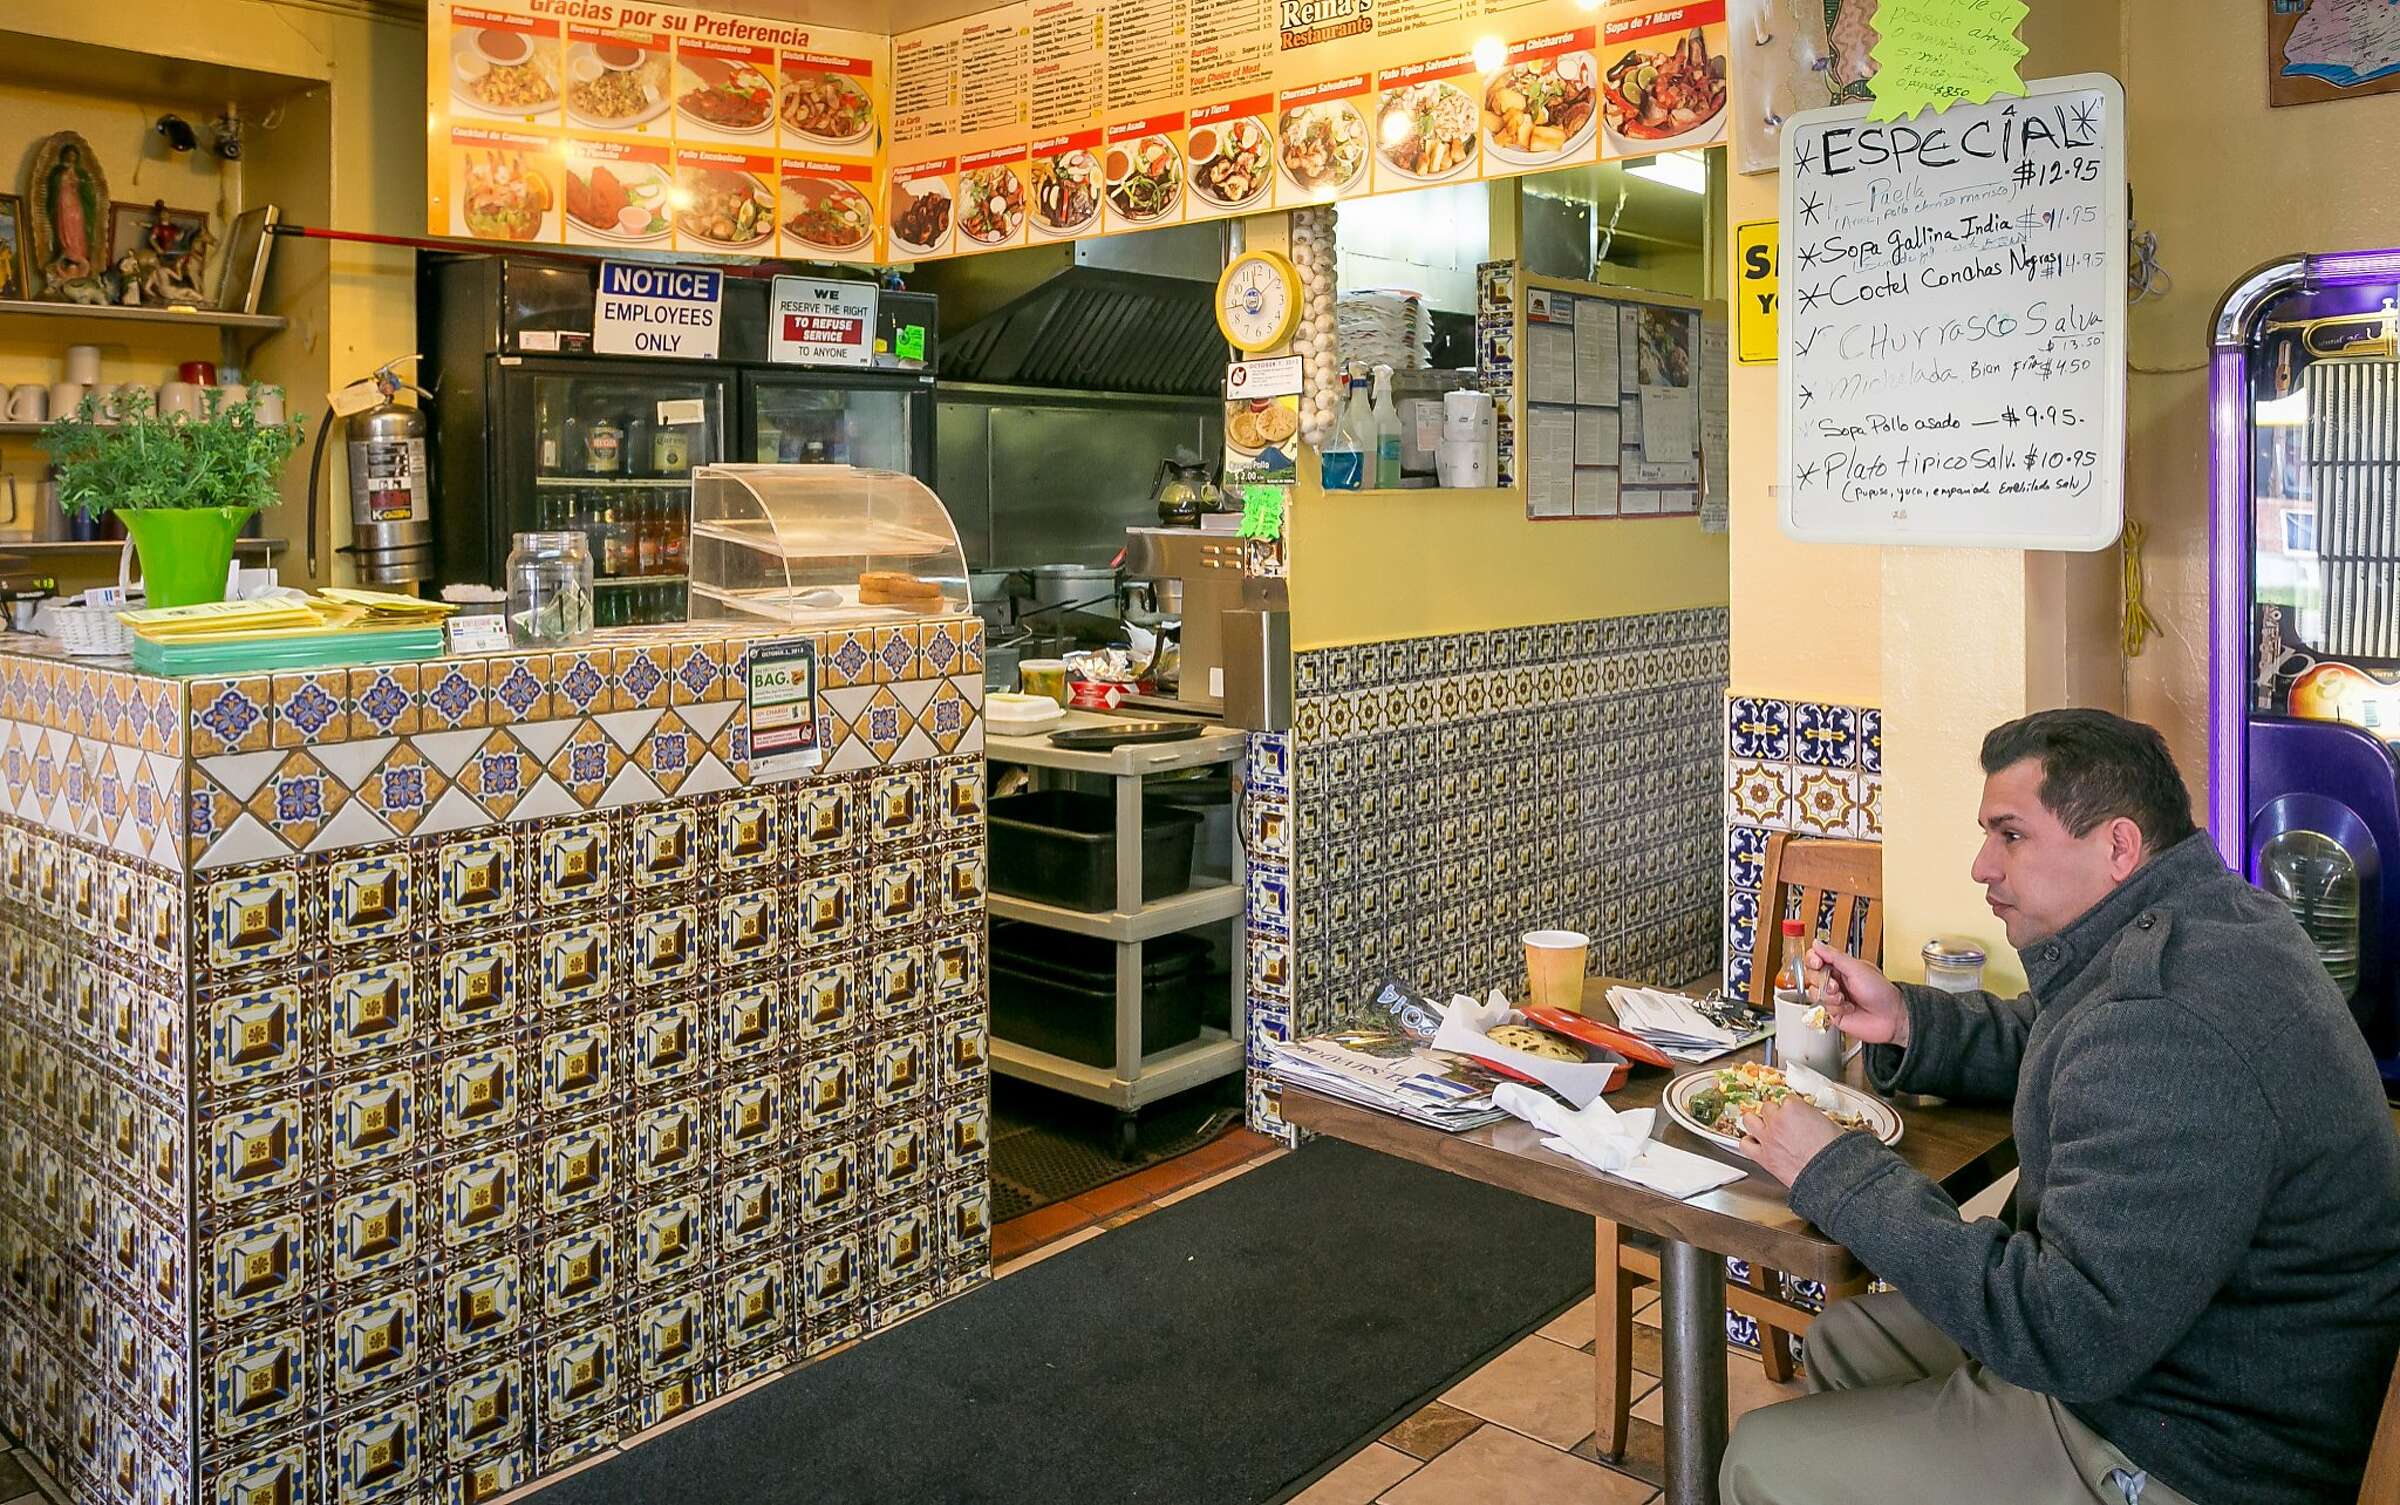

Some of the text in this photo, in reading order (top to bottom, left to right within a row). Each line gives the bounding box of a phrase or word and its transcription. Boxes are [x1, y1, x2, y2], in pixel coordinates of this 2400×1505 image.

[530, 0, 810, 47] Gracias por su Preferencia
[1281, 15, 1372, 51] Restaurante
[1606, 10, 1683, 34] Sopa de 7 Mares
[1379, 69, 1400, 80] Plato
[2012, 157, 2101, 190] $12.95
[1819, 236, 1882, 268] Sopa
[1959, 213, 2013, 239] India
[1745, 244, 1779, 279] S
[613, 267, 710, 299] NOTICE
[814, 288, 839, 300] WE
[1829, 271, 1910, 306] Coctel
[604, 302, 713, 327] EMPLOYEES
[780, 301, 868, 317] RESERVE THE RIGHT
[795, 317, 853, 330] TO REFUSE
[803, 330, 843, 342] SERVICE
[635, 333, 681, 352] ONLY
[798, 346, 847, 358] TO ANYONE
[1818, 418, 1867, 441] Sopa
[1866, 414, 1909, 434] Pollo
[1824, 445, 1888, 490] Plato
[2024, 443, 2096, 471] $10.95
[755, 671, 790, 688] BAG.
